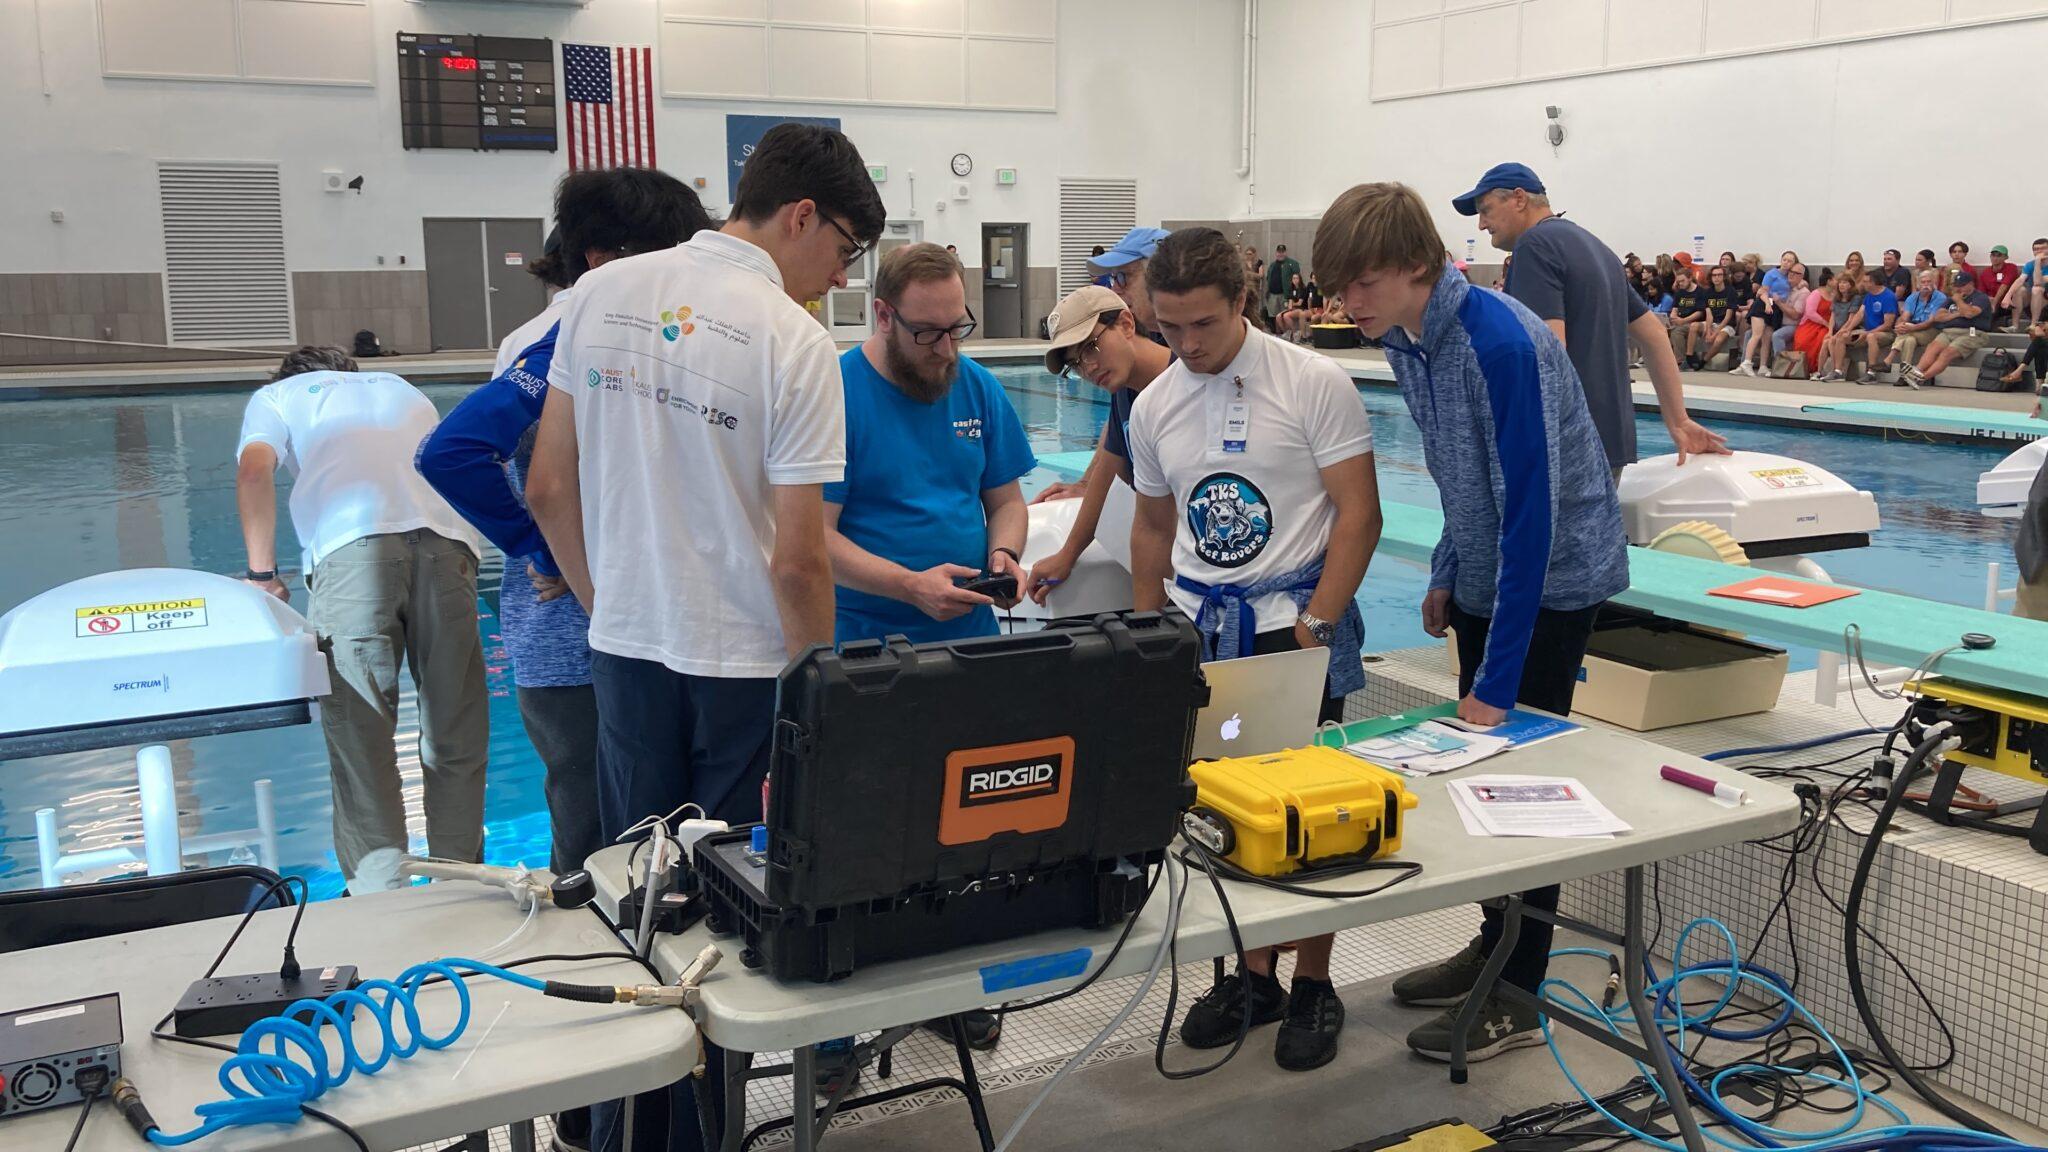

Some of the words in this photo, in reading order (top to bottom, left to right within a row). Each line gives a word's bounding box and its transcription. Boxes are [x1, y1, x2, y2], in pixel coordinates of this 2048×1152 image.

[515, 369, 546, 390] KAUST
[1207, 482, 1240, 501] TKS
[1220, 534, 1264, 562] Rovers
[107, 600, 193, 615] CAUTION
[146, 610, 194, 620] Keep
[146, 619, 173, 631] off
[113, 679, 162, 692] SPECTRUM
[1872, 674, 1879, 684] 5
[969, 763, 1054, 792] RIDGID
